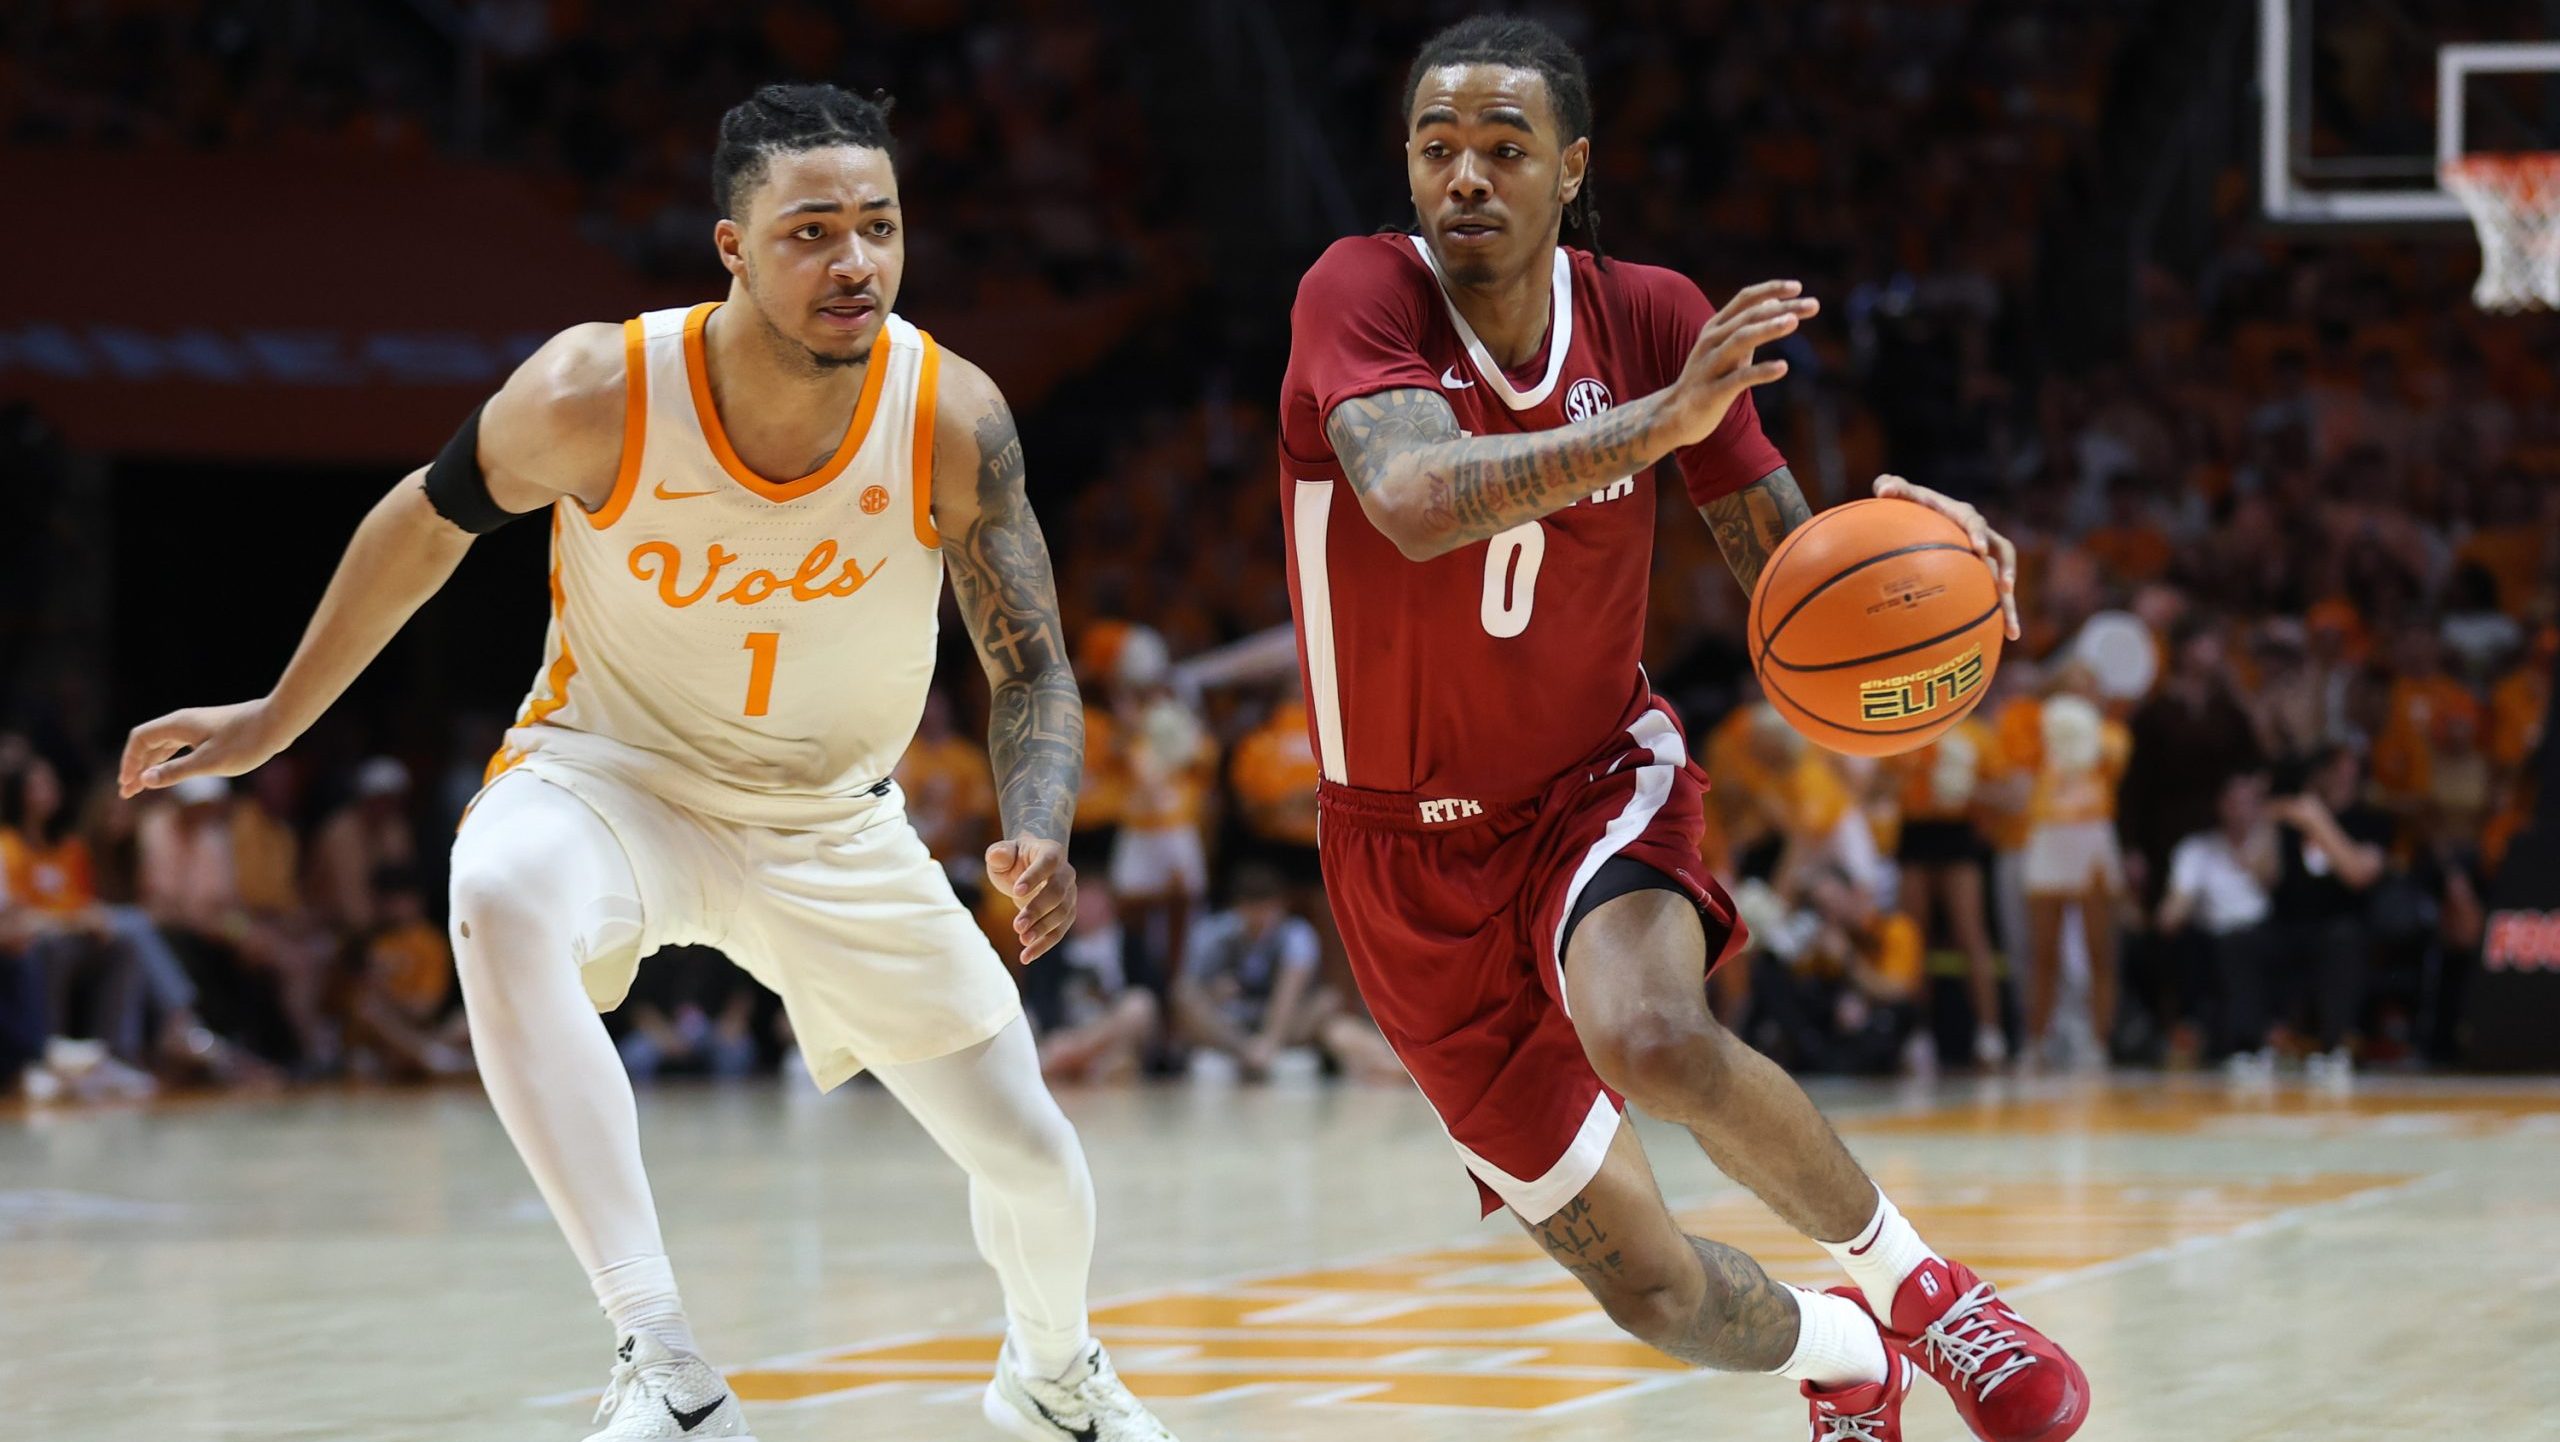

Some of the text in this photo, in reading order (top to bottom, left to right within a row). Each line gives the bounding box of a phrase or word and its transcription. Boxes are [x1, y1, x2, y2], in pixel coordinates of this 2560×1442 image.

[1568, 381, 1608, 422] SEC
[628, 539, 888, 608] Vols
[1481, 520, 1546, 638] 0
[742, 632, 781, 717] 1
[1860, 652, 1984, 722] ELITE
[1544, 1218, 1608, 1255] ALL
